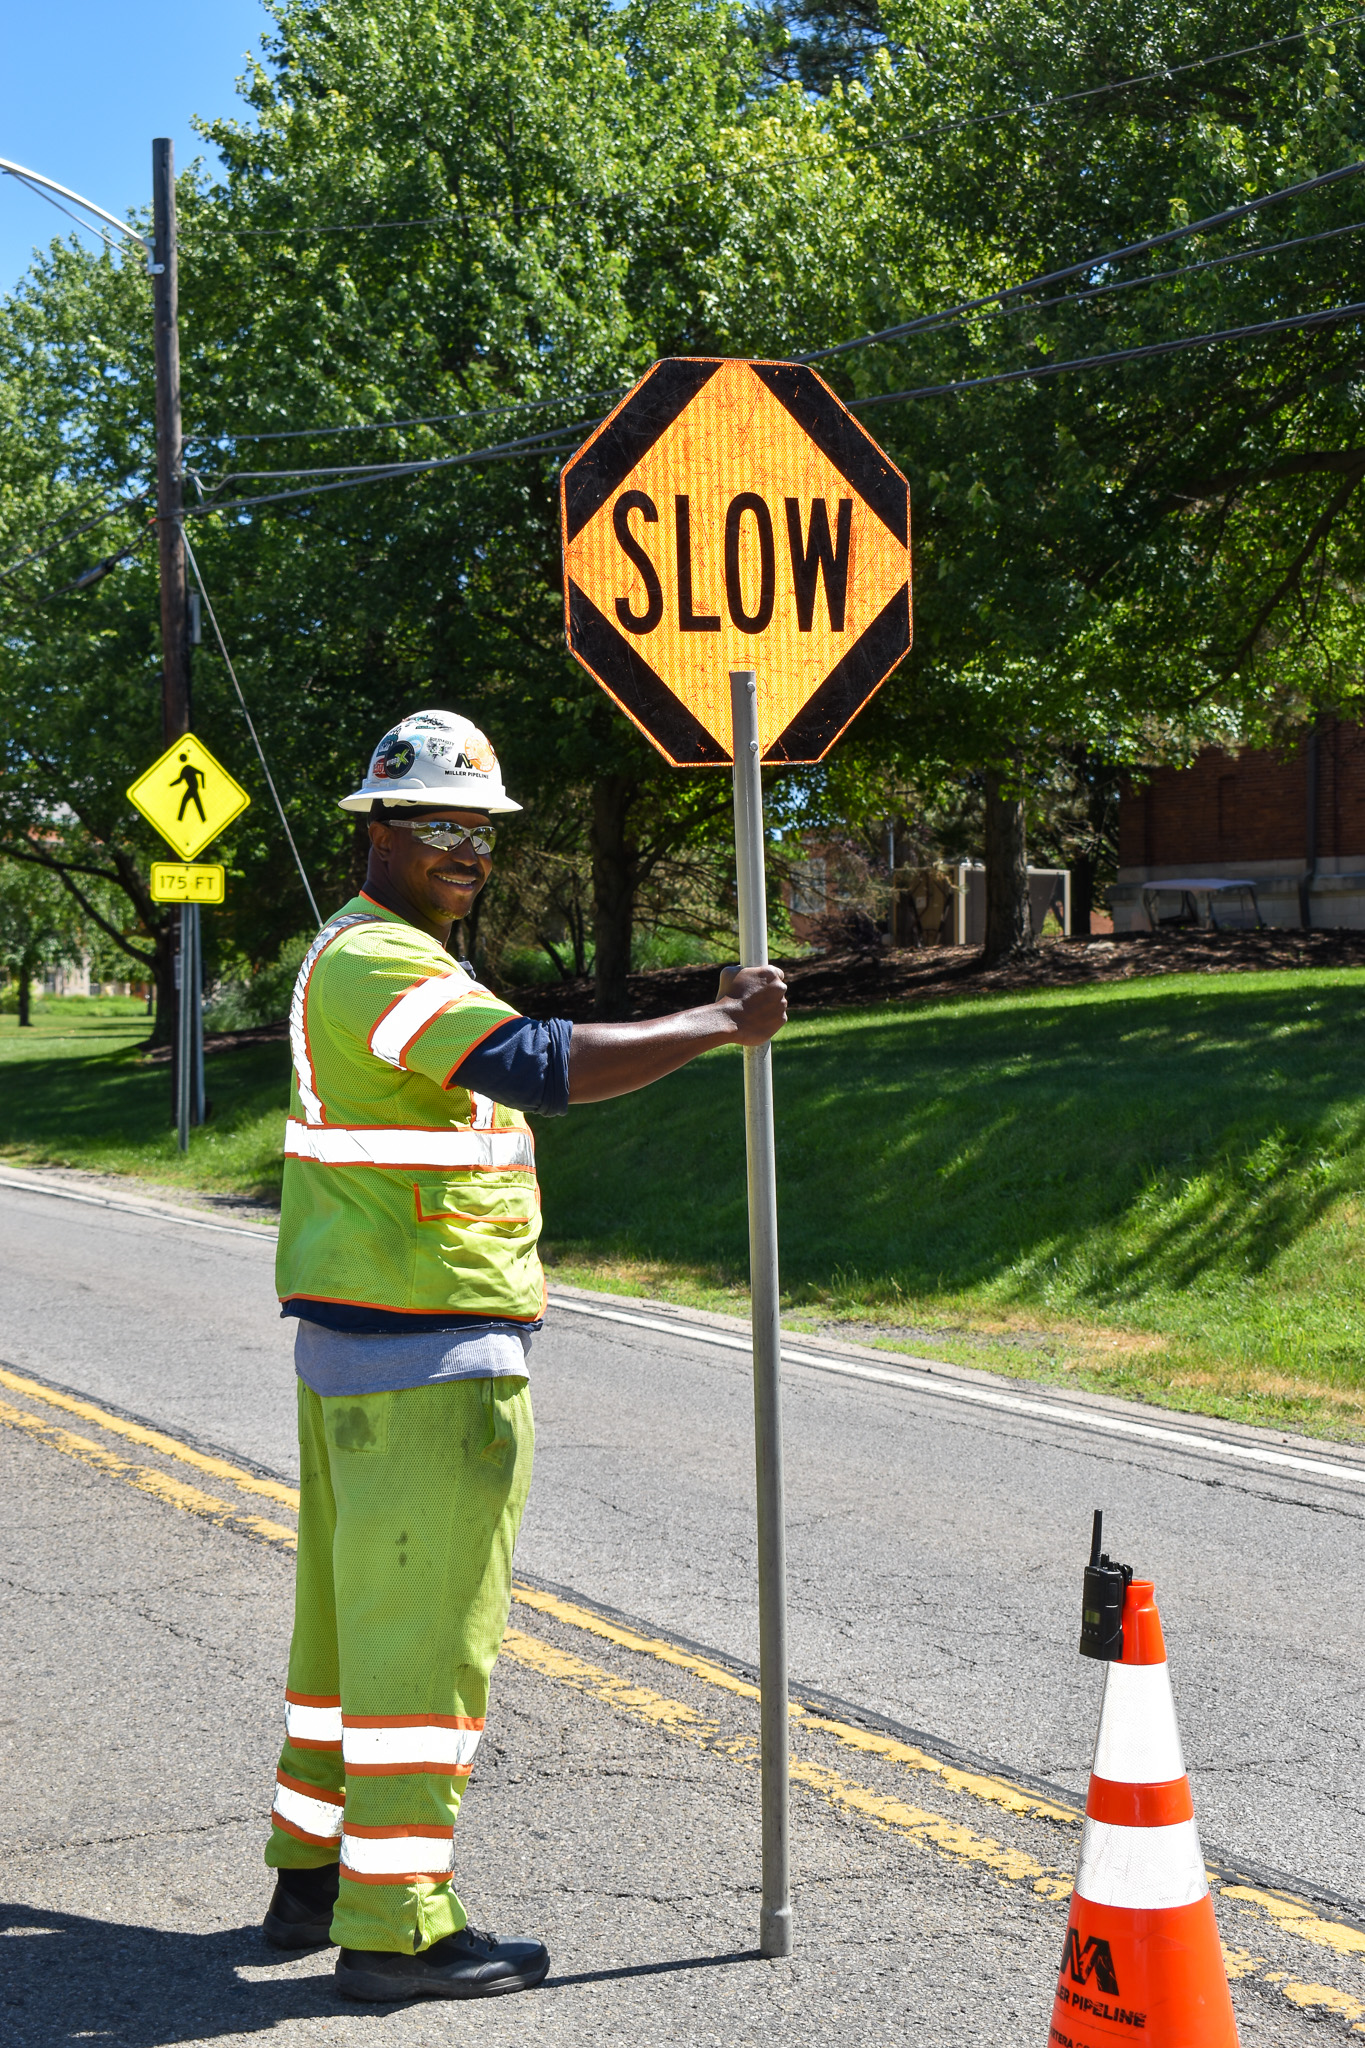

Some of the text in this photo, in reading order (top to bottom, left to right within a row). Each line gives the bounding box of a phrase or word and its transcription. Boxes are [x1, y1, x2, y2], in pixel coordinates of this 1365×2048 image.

[612, 490, 853, 635] SLOW
[467, 771, 489, 779] PIPELINE
[160, 875, 215, 890] 175 FT
[1071, 1992, 1147, 2028] PIPELINE
